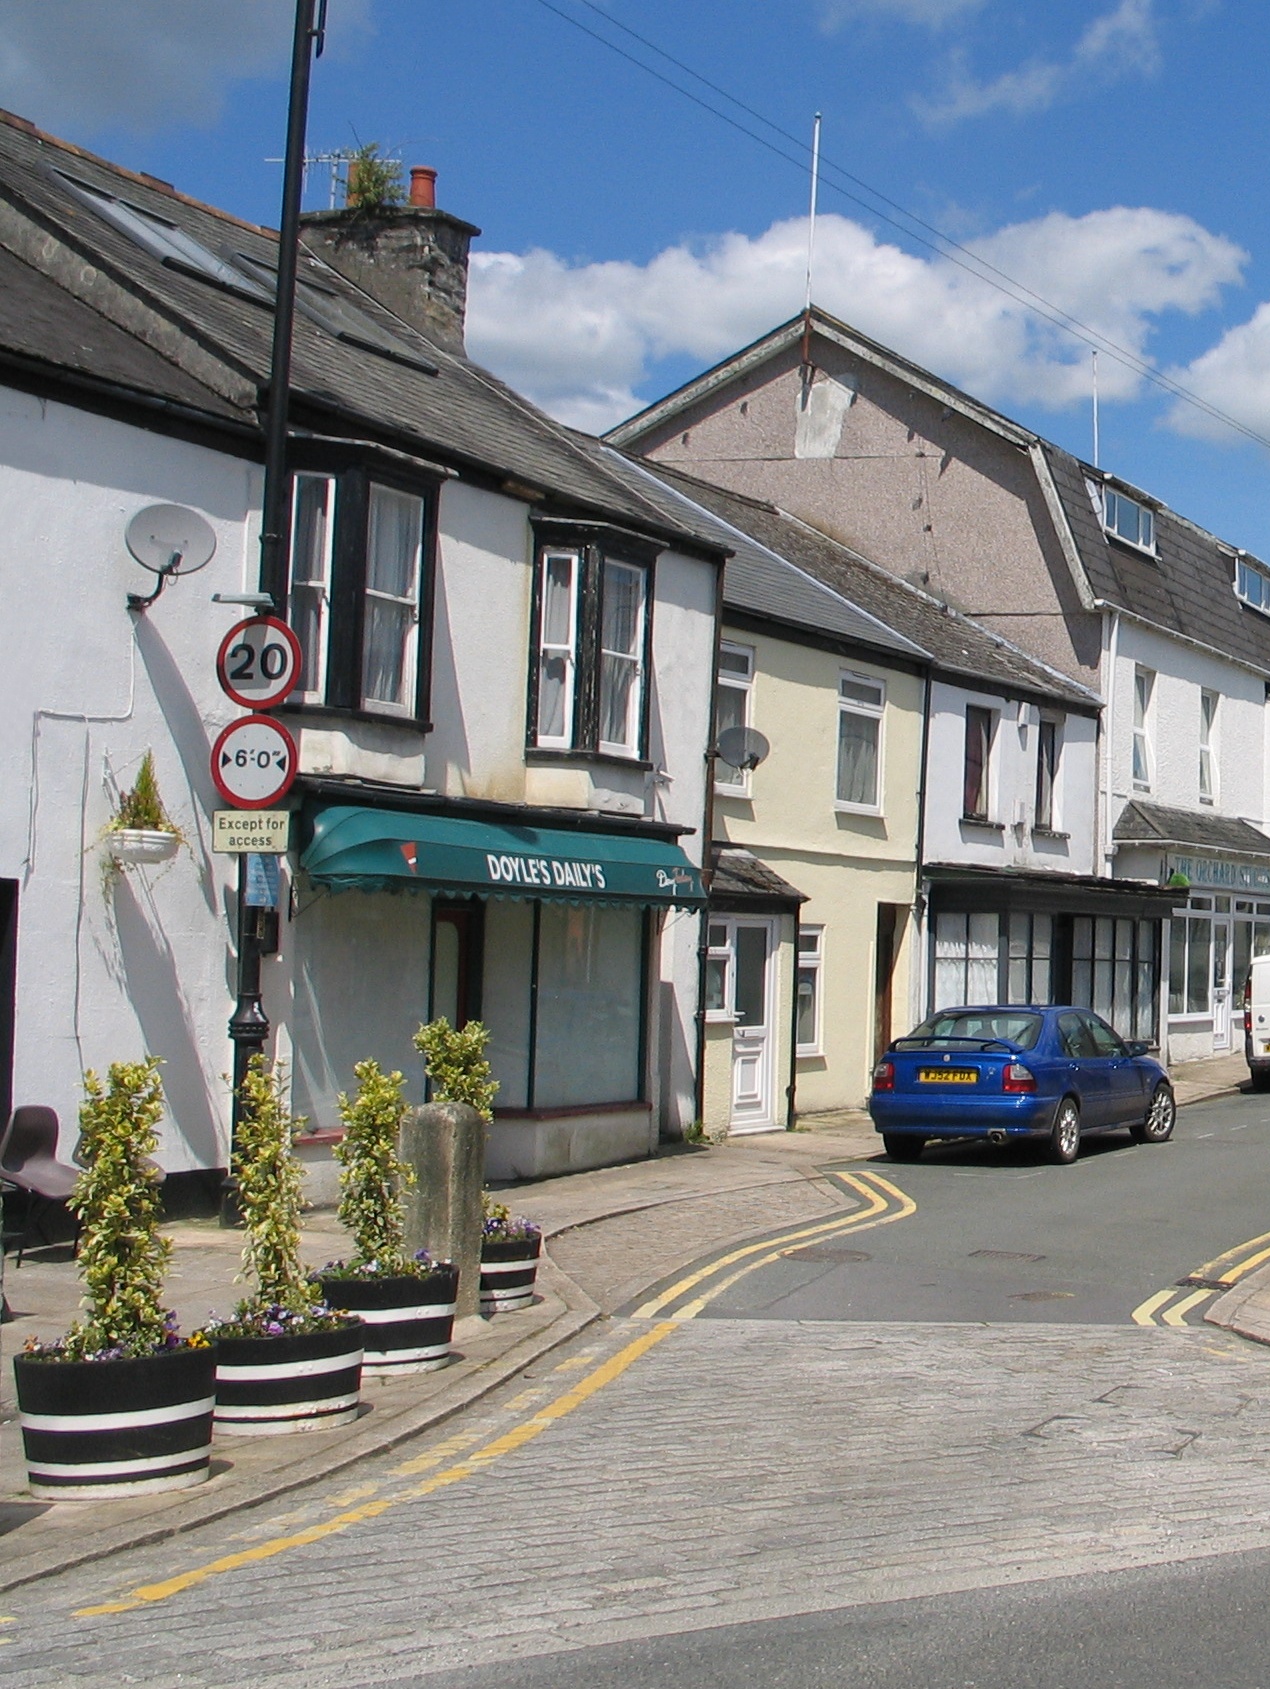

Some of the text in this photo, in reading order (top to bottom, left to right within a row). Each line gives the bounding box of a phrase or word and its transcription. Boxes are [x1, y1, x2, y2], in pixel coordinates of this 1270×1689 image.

[229, 643, 288, 681] 20
[218, 817, 285, 834] Except for
[229, 836, 273, 847] access
[487, 854, 606, 889] DOYLE'S DAILY'S
